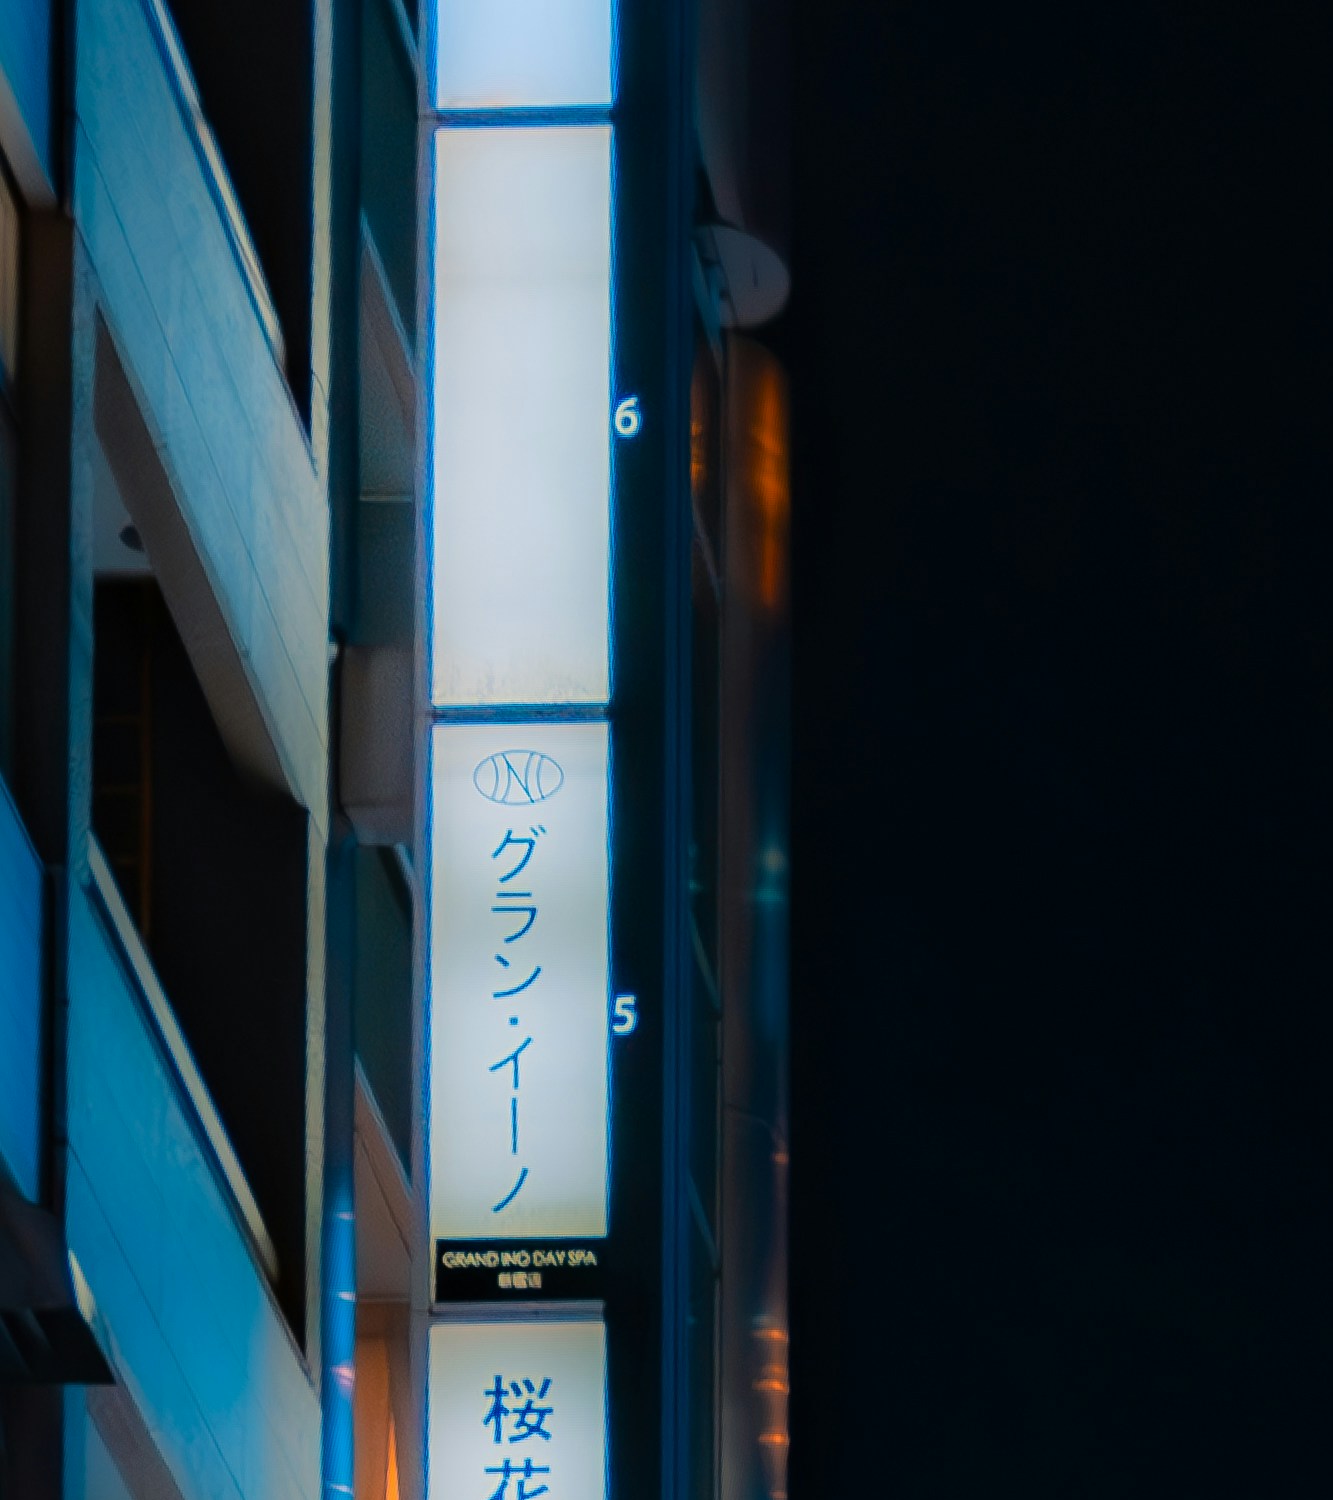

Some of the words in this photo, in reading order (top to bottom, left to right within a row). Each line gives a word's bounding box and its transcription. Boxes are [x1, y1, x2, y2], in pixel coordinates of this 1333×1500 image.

[614, 398, 639, 435] 6
[487, 826, 544, 1214] グラン・イーノ
[612, 996, 637, 1034] 5
[442, 1251, 498, 1268] GRAND
[533, 1250, 565, 1266] DAY
[567, 1249, 597, 1266] SPA
